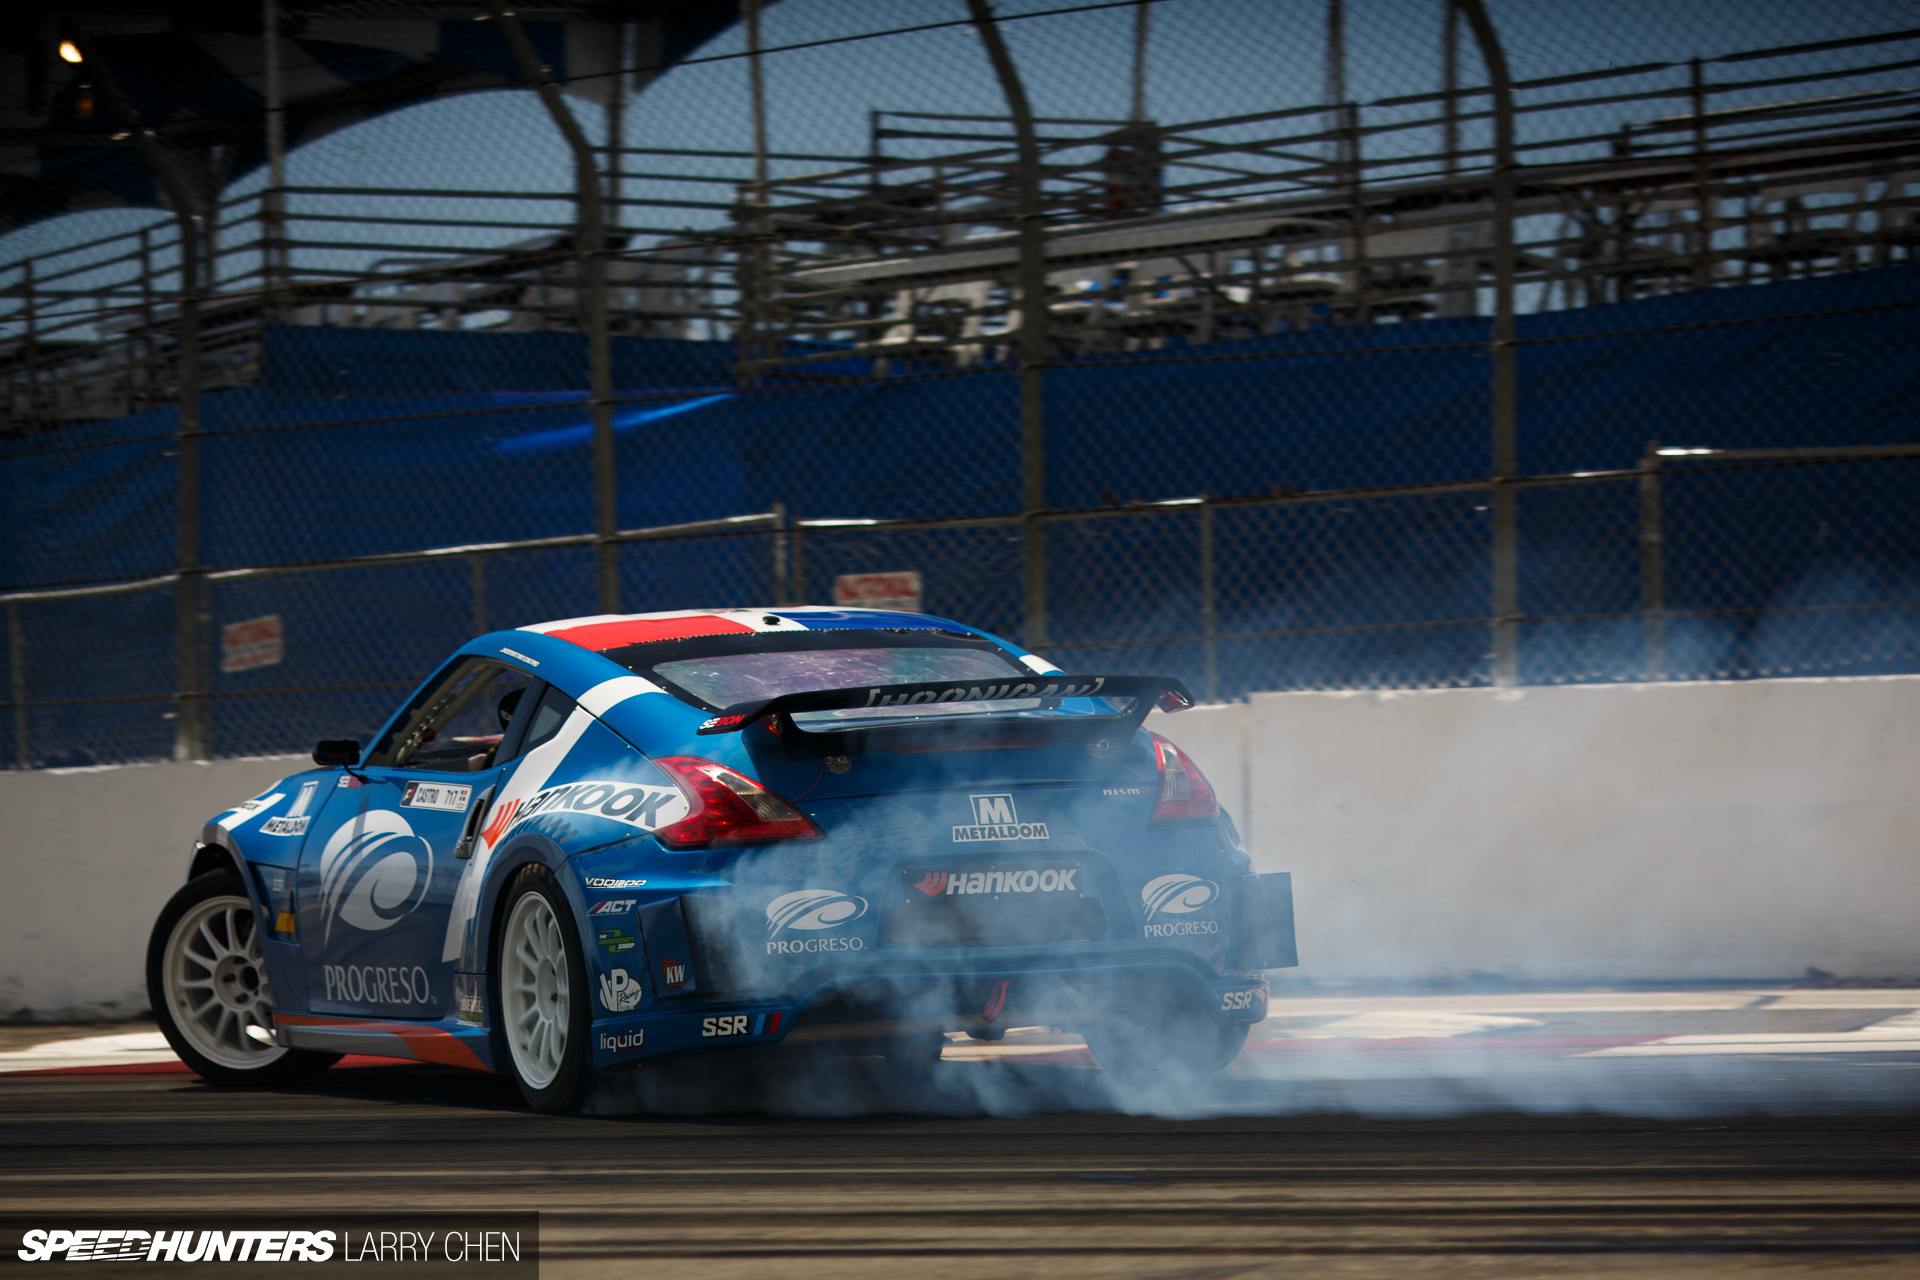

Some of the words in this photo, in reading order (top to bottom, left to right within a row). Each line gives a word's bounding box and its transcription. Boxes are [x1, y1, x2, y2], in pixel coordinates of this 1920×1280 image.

[979, 797, 1014, 824] M
[954, 824, 1048, 841] METALDOM
[596, 900, 637, 914] ACT
[1143, 921, 1219, 938] PROGRESO
[766, 937, 864, 955] PROGRESO
[666, 964, 685, 984] KW
[323, 965, 430, 1005] PROGRESO
[1221, 991, 1252, 1011] SSR
[702, 1015, 748, 1037] SSR
[600, 1029, 644, 1053] liquid
